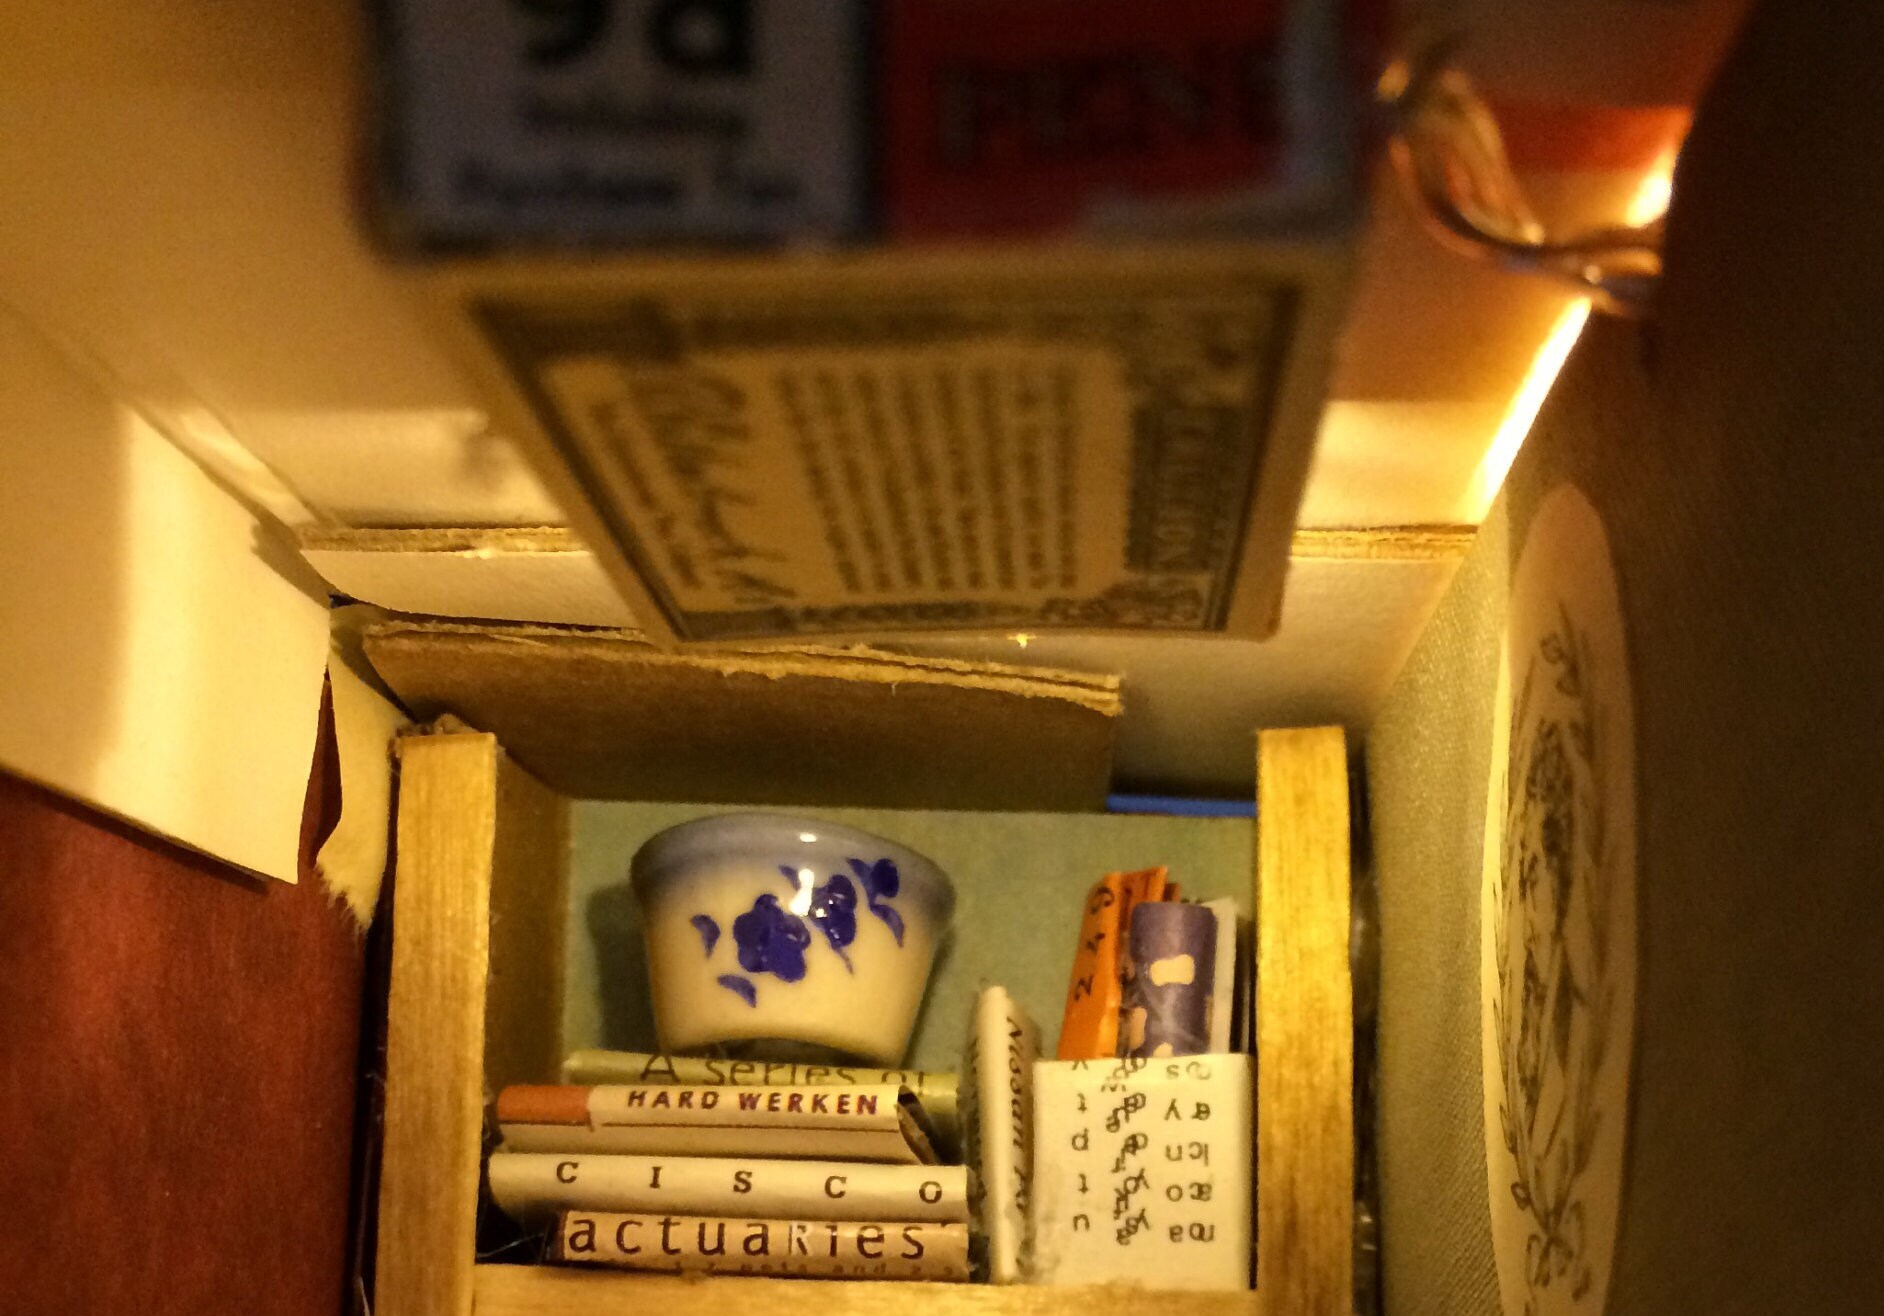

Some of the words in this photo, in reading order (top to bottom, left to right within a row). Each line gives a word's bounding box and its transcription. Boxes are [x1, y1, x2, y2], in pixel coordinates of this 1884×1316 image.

[627, 1090, 721, 1110] HARD
[738, 1092, 878, 1116] WERKEN
[556, 1161, 943, 1204] CISCO
